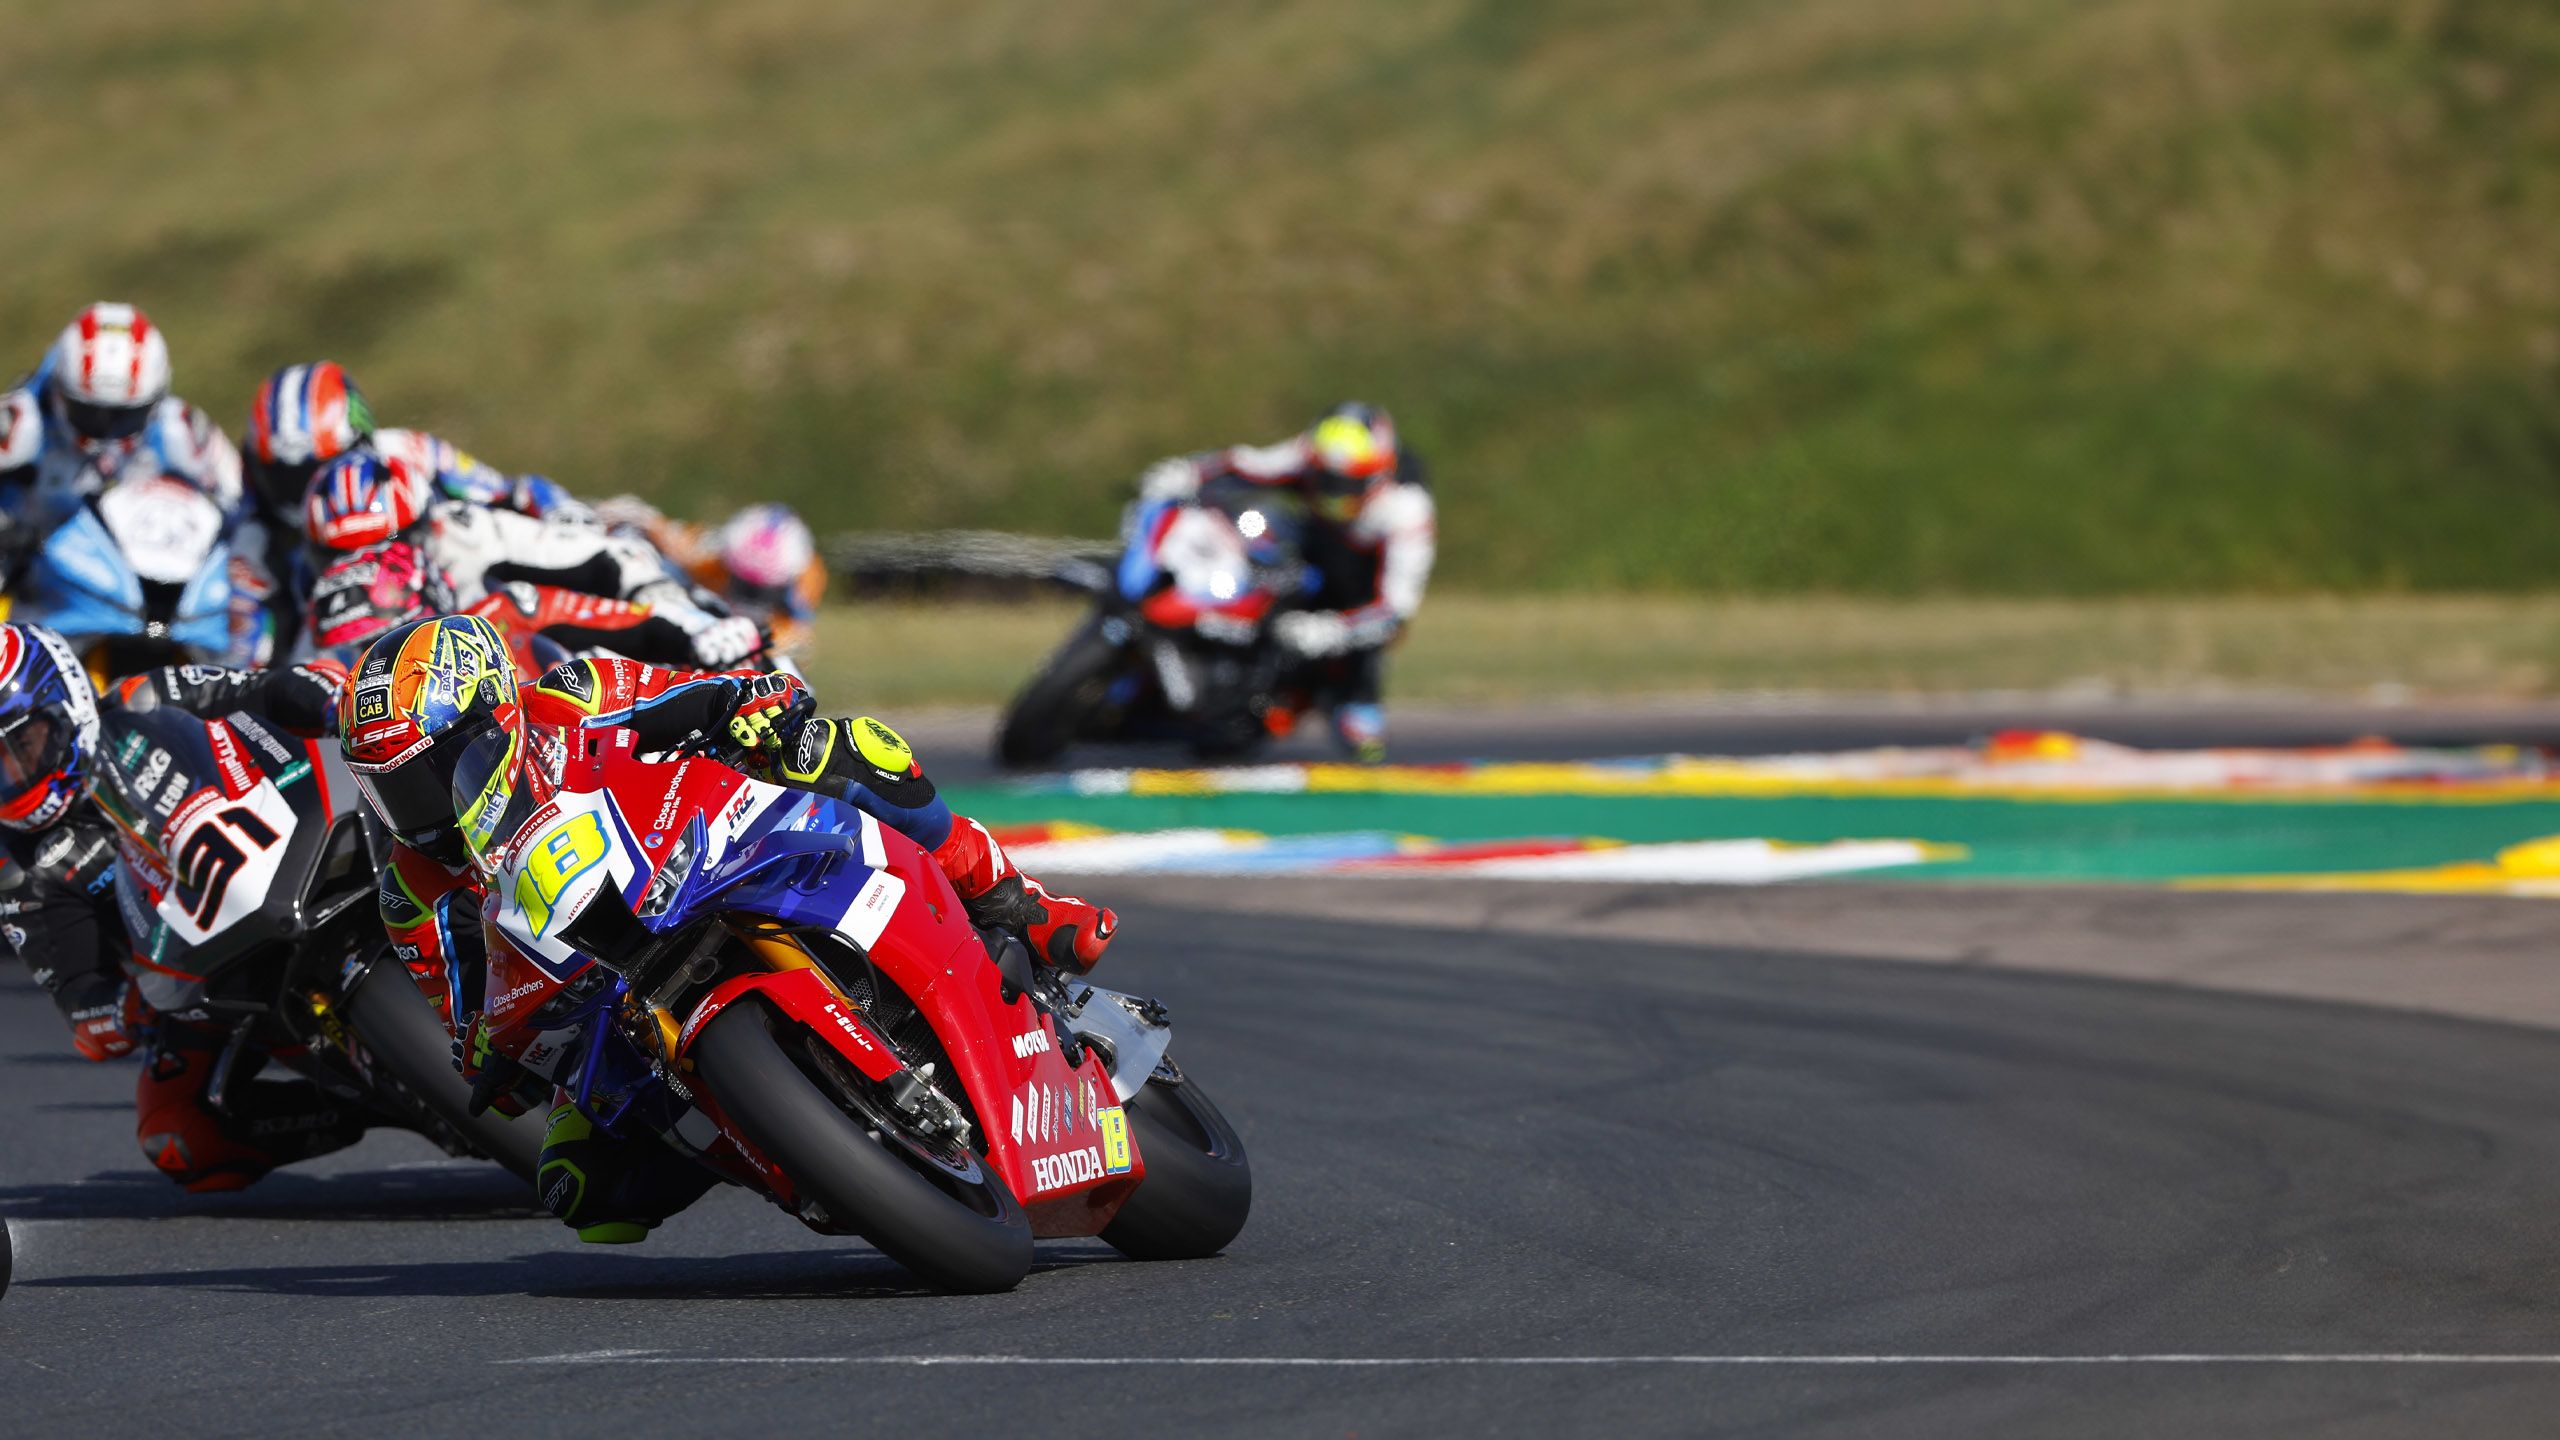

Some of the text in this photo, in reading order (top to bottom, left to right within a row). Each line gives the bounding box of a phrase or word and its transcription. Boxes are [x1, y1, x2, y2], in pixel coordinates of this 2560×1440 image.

[359, 703, 384, 718] CAB
[360, 694, 381, 707] fona
[351, 721, 410, 748] LS2
[615, 728, 630, 748] MOTUL
[797, 718, 819, 774] RST
[379, 750, 415, 773] ROOFING
[415, 738, 433, 752] LTD
[133, 747, 173, 801] R&G
[154, 771, 190, 819] LEON
[483, 790, 505, 820] MET
[653, 760, 691, 830] Close Brothers
[671, 796, 682, 812] Hire
[515, 806, 558, 848] Bennetts
[175, 807, 282, 933] 91
[513, 810, 612, 943] 18
[380, 889, 413, 909] ST
[567, 887, 596, 921] HONDA
[866, 883, 885, 909] HONDA
[493, 979, 544, 1008] Close Brothers
[823, 1003, 874, 1052] PIRELLI
[1012, 1029, 1050, 1059] MOTUL
[724, 1127, 768, 1175] PIRELLI
[1097, 1106, 1132, 1176] 18
[1031, 1146, 1104, 1192] HONDA
